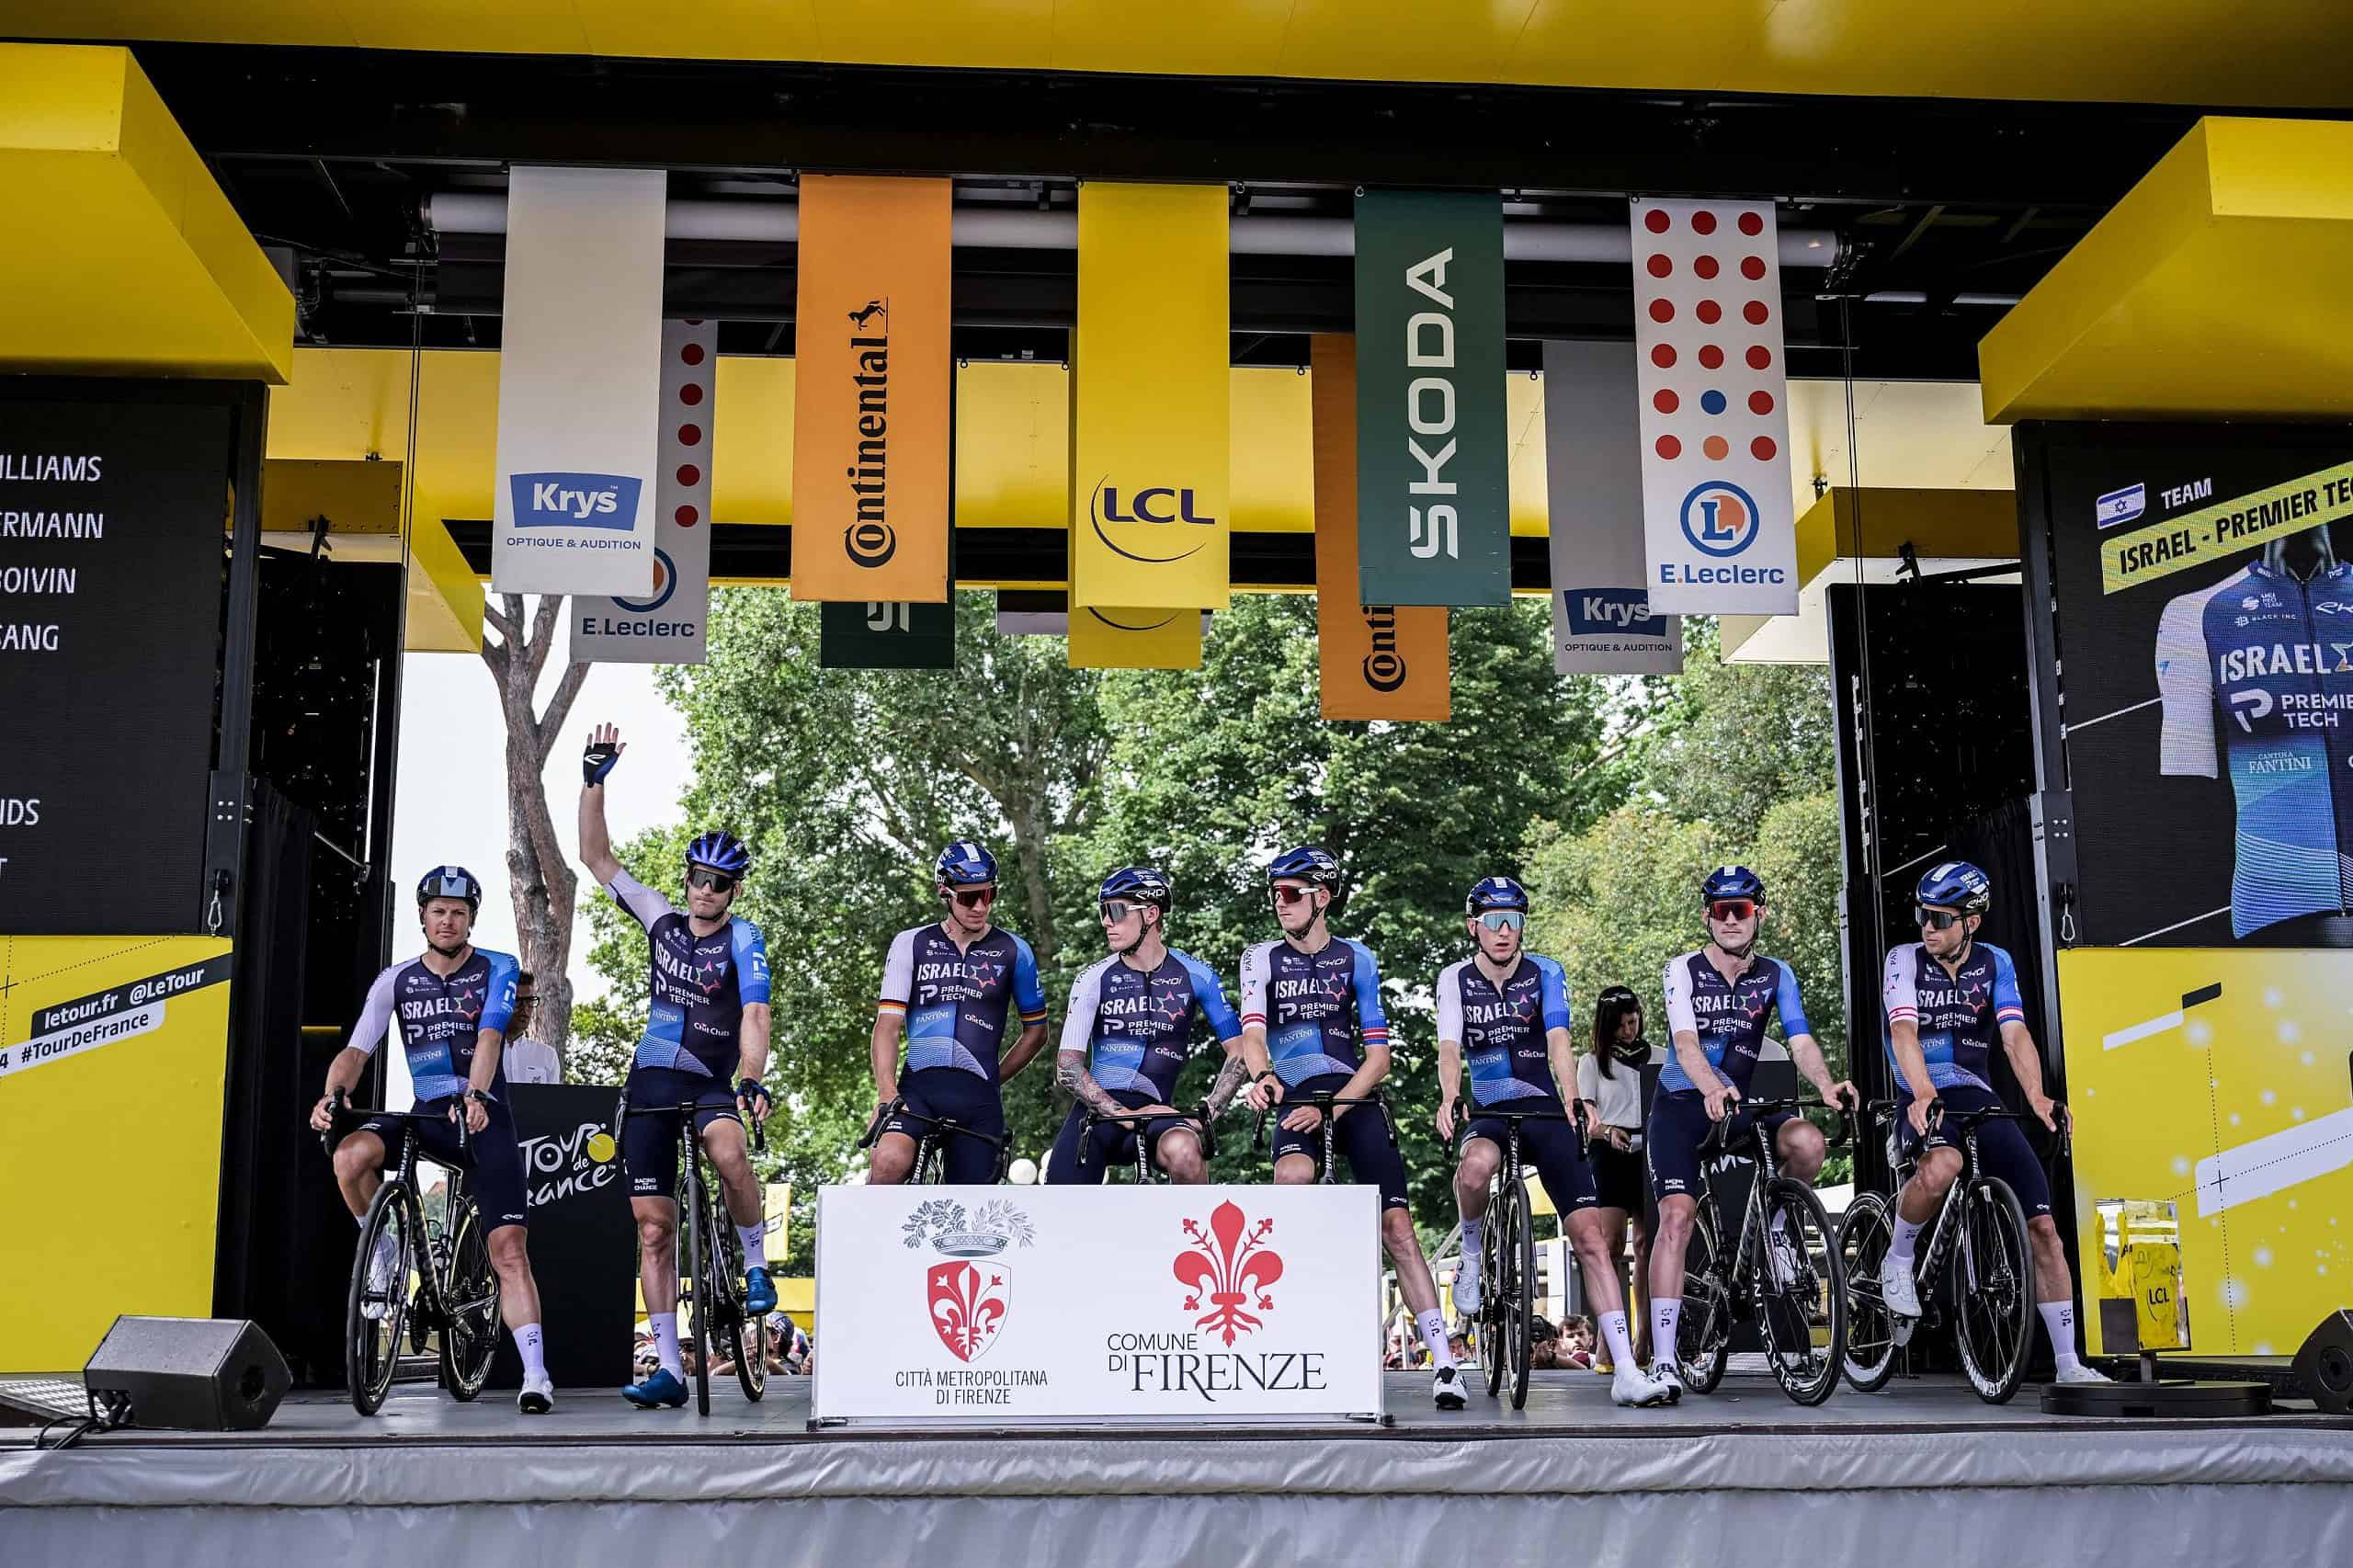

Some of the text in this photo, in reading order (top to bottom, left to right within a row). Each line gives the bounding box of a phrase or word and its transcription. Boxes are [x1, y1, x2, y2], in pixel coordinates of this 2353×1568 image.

[844, 335, 897, 568] Continental
[0, 454, 103, 482] ILLIAMS
[2161, 477, 2212, 509] TEAM
[1104, 487, 1215, 525] LCL
[0, 512, 104, 539] RMANN
[2120, 529, 2197, 574] ISRAEL
[2215, 489, 2318, 543] PREMIER
[2323, 476, 2353, 507] TE
[506, 537, 642, 551] OPTIQUE & AUDITION
[0, 567, 76, 594] OIVIN
[1660, 563, 1785, 585] E.Leclerc
[0, 624, 60, 651] ANG
[582, 618, 695, 638] E.Leclerc
[1564, 642, 1673, 653] OPTIQUE & AUDITION
[2220, 643, 2332, 685] ISRAEL
[2282, 712, 2339, 728] TECH
[2249, 756, 2312, 773] FANTINI
[654, 938, 694, 983] ISRAEL
[917, 962, 969, 982] ISRAEL
[669, 985, 710, 1006] PREMIER
[940, 984, 983, 999] PREMIER
[940, 994, 965, 1002] TECH
[1275, 978, 1324, 999] ISRAEL
[44, 968, 204, 1029] letour.fr @LeTour
[669, 994, 694, 1008] TECH
[1100, 996, 1156, 1016] ISRAEL
[1301, 1002, 1340, 1012] PREMIER
[1917, 989, 1961, 1008] SRAEL
[401, 997, 453, 1020] ISRAEL
[1301, 1010, 1326, 1019] TECH
[1463, 1002, 1510, 1023] ISRAEL
[1936, 1012, 1977, 1024] PREMIER
[427, 1022, 474, 1033] PREMIER
[1128, 1020, 1174, 1031] PREMIER
[1129, 1028, 1156, 1037] TECH
[1488, 1026, 1529, 1037] PREMIER
[1711, 1026, 1737, 1034] TECH
[1712, 1017, 1752, 1029] PREMIER
[1936, 1021, 1961, 1029] TECH
[21, 1013, 150, 1063] #TourDeFrance
[427, 1029, 456, 1041] TECH
[1489, 1033, 1514, 1044] TECH
[573, 1154, 589, 1171] de
[1753, 1266, 1764, 1308] INC
[2148, 1288, 2170, 1305] LCL
[1108, 1333, 1198, 1351] COMUNE
[895, 1368, 1048, 1387] CITTÀ METROPOLITANA
[1108, 1353, 1327, 1402] DI FIRENZE
[936, 1389, 1011, 1404] DI FIRENZE
